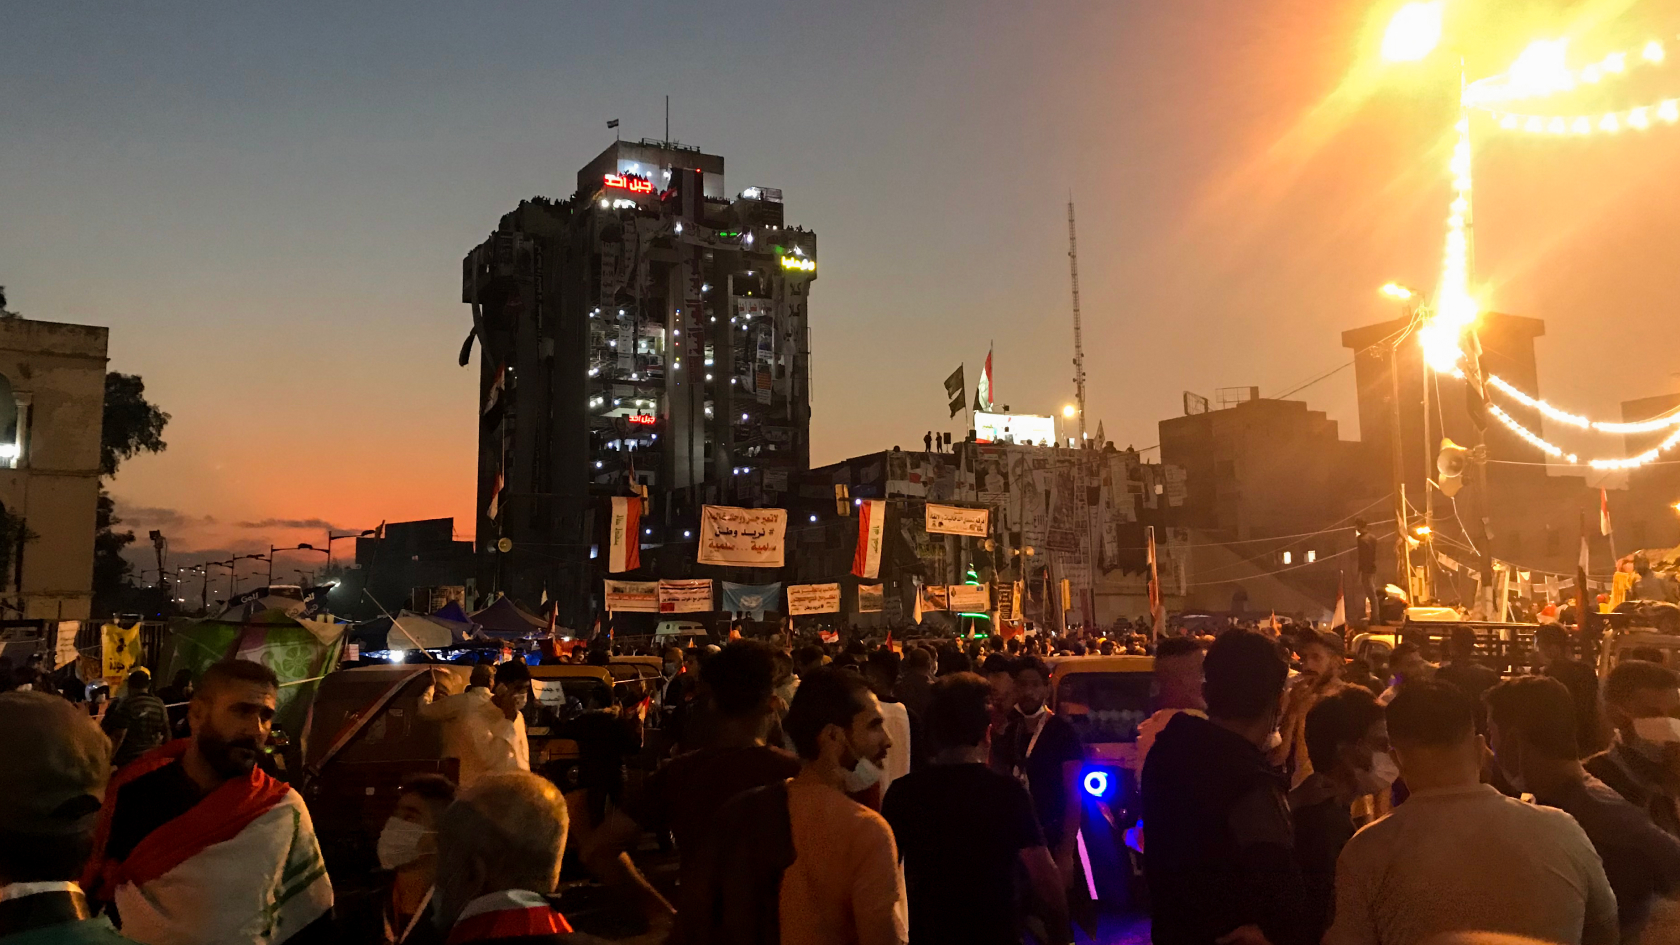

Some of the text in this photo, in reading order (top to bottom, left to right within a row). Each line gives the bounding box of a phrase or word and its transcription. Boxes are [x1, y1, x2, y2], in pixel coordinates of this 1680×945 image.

[629, 178, 652, 194] جبل
[641, 415, 656, 425] جبل
[714, 526, 738, 538] وطن
[741, 527, 766, 539] نريد
[708, 538, 735, 553] سلمية
[750, 540, 776, 554] سلمية
